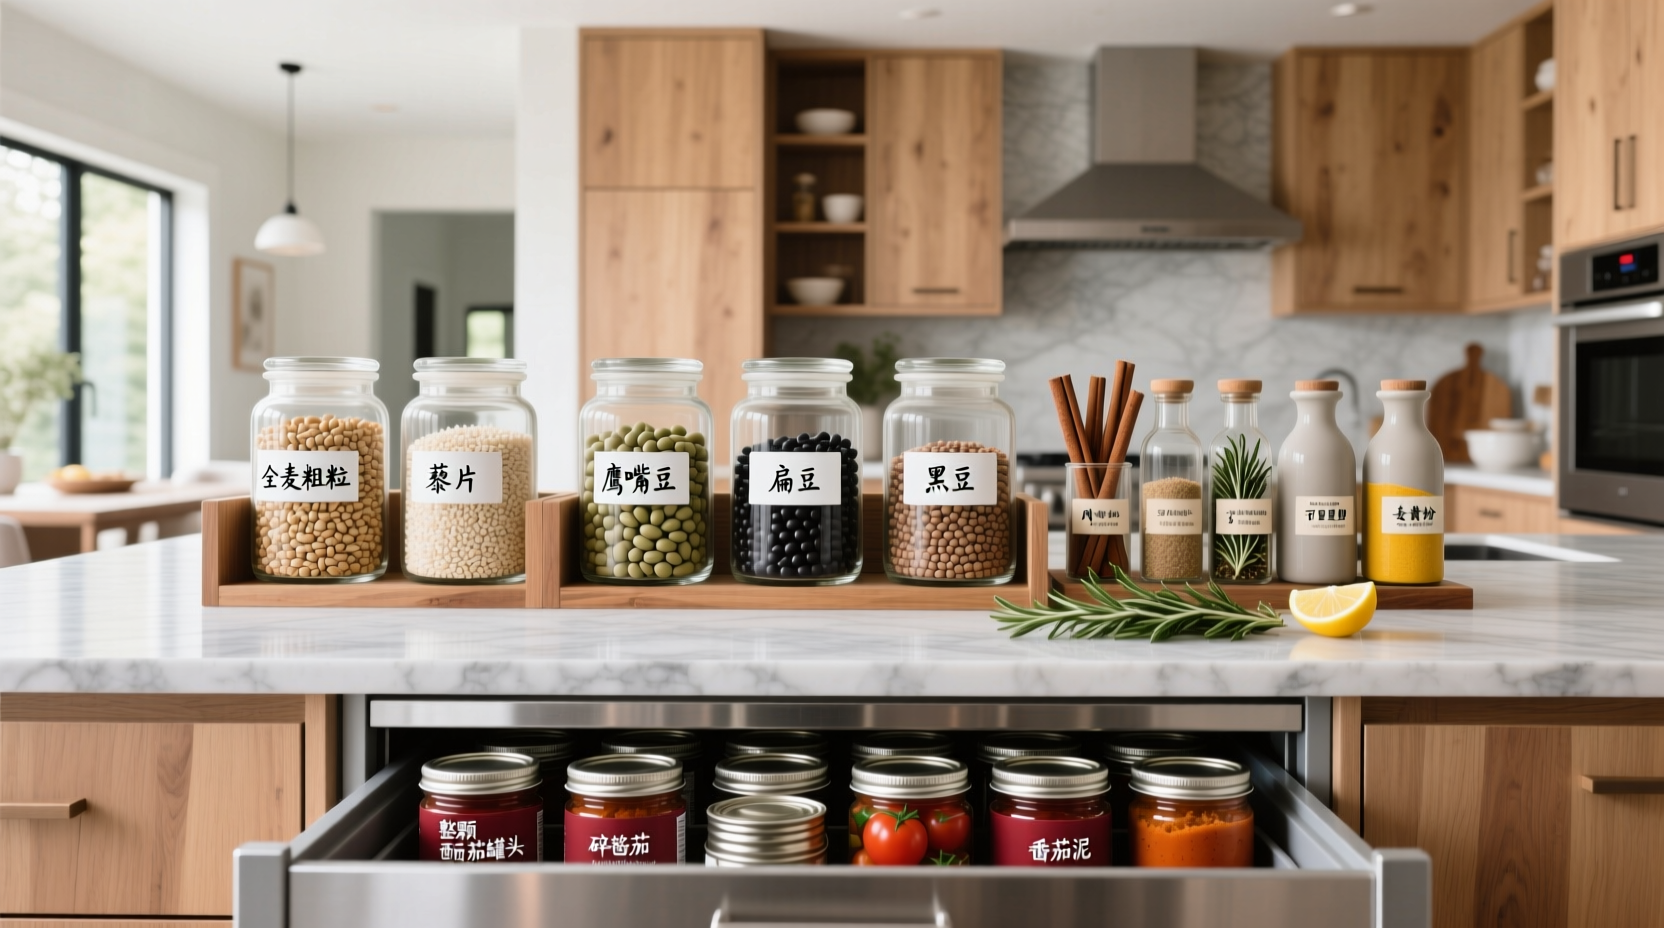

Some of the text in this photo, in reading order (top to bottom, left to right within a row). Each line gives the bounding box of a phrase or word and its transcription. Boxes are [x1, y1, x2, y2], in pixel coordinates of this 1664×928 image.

[261, 462, 351, 490] 全麦粗粒
[426, 463, 476, 494] 藜片
[602, 463, 677, 495] 鹰嘴豆
[768, 464, 821, 493] 扁豆
[925, 465, 975, 494] 黑豆
[1028, 837, 1092, 863] 番茄泥
